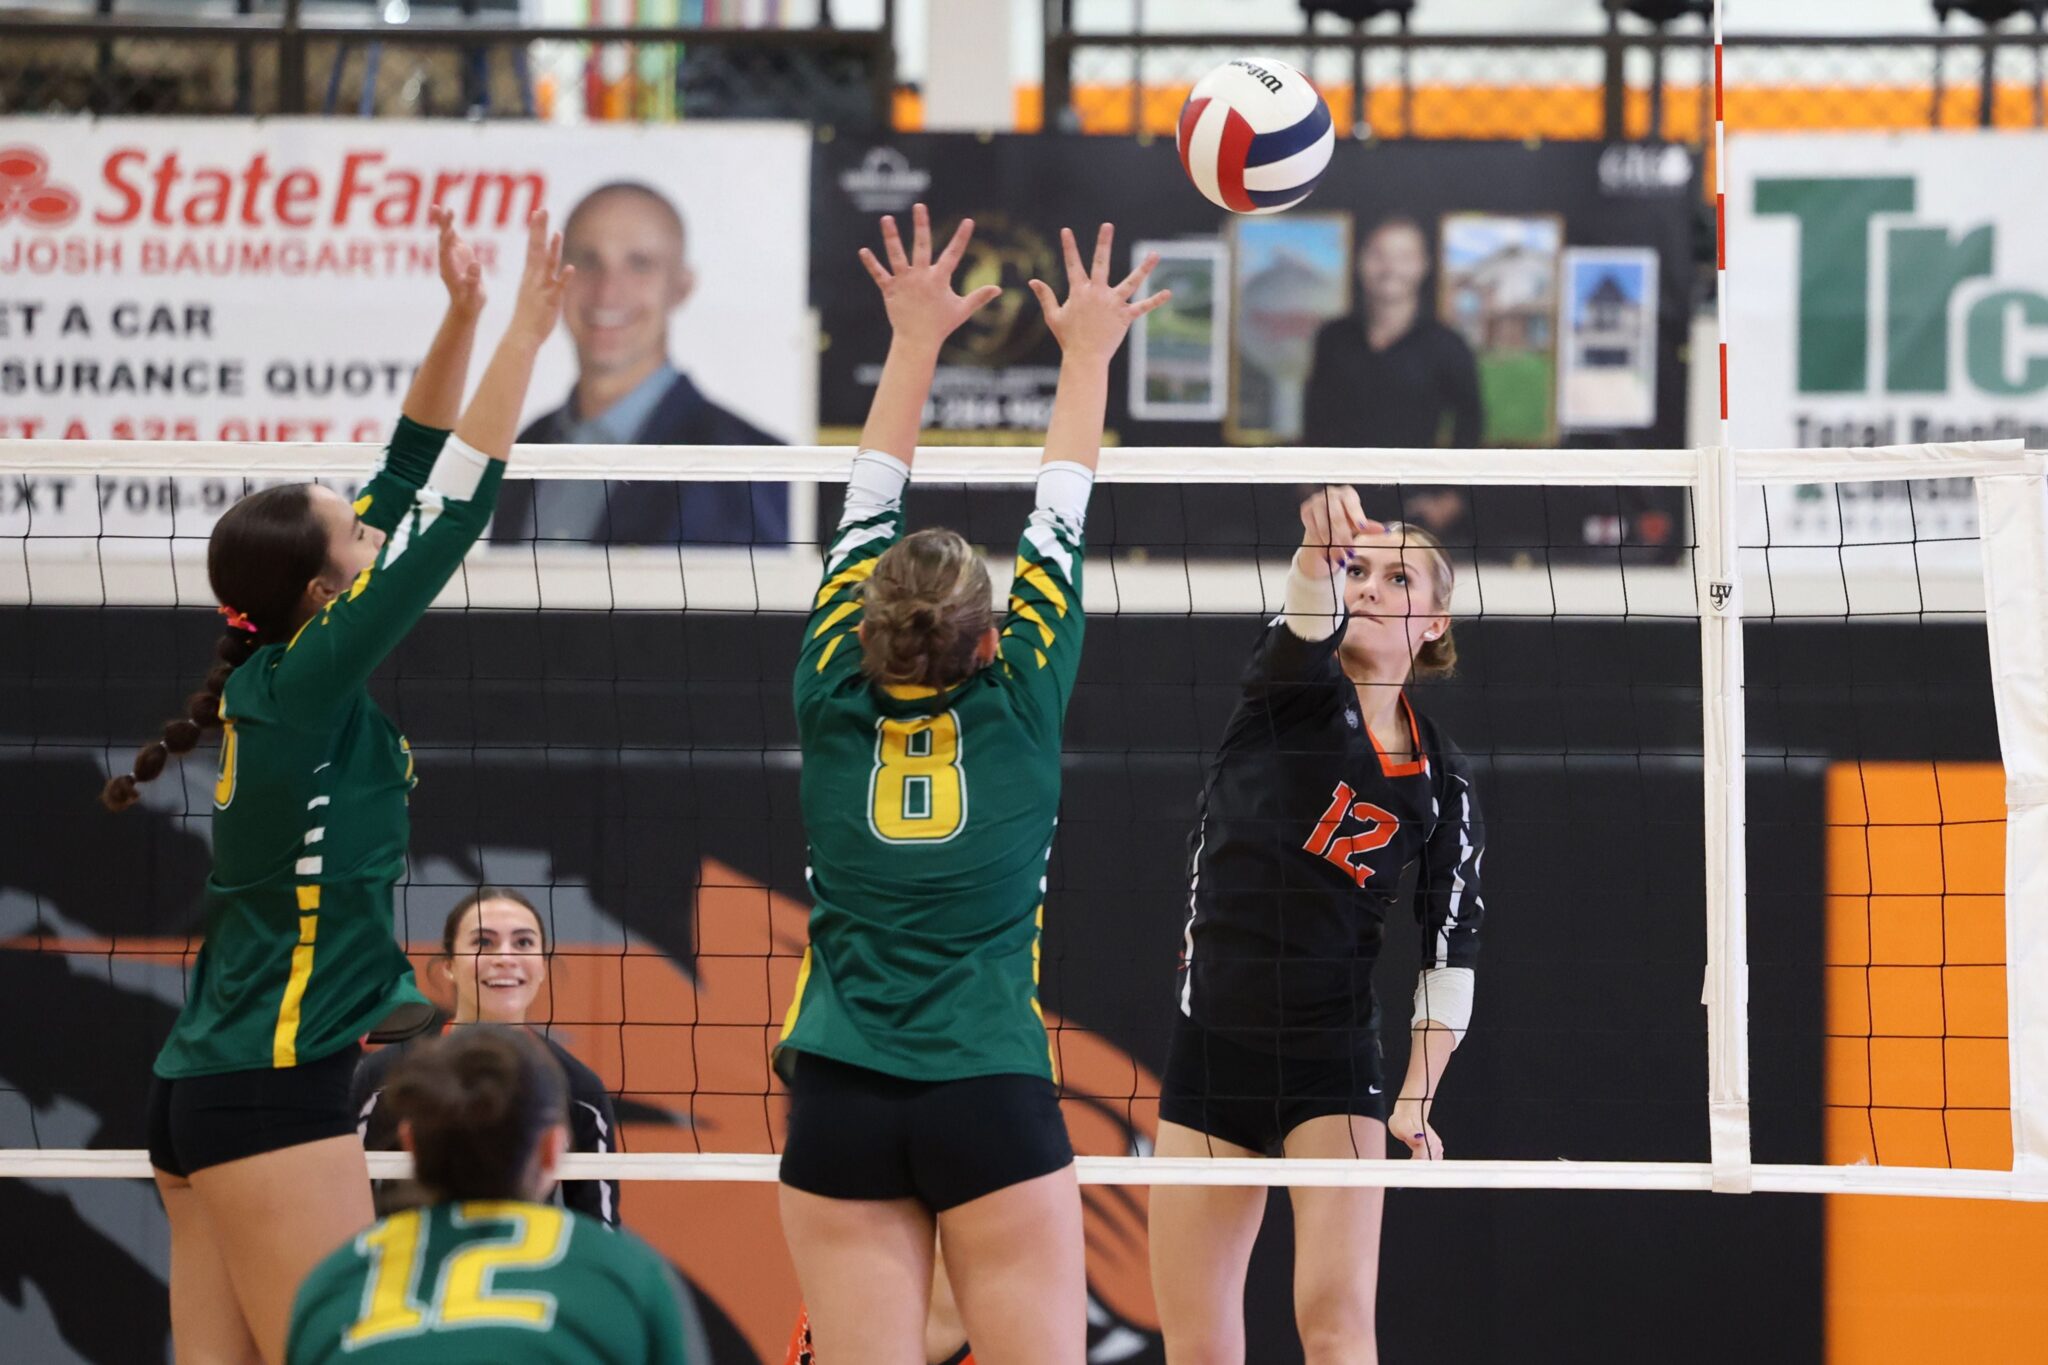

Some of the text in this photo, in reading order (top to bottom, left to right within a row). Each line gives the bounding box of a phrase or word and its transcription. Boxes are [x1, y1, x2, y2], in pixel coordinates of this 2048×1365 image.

[1, 237, 497, 277] JOSH BAUMGARTNR
[61, 302, 91, 337] A
[112, 302, 212, 338] CAR
[3, 361, 419, 397] SURANCE QUOT
[867, 708, 967, 845] 8
[1302, 780, 1399, 888] 12
[342, 1202, 574, 1352] 12
